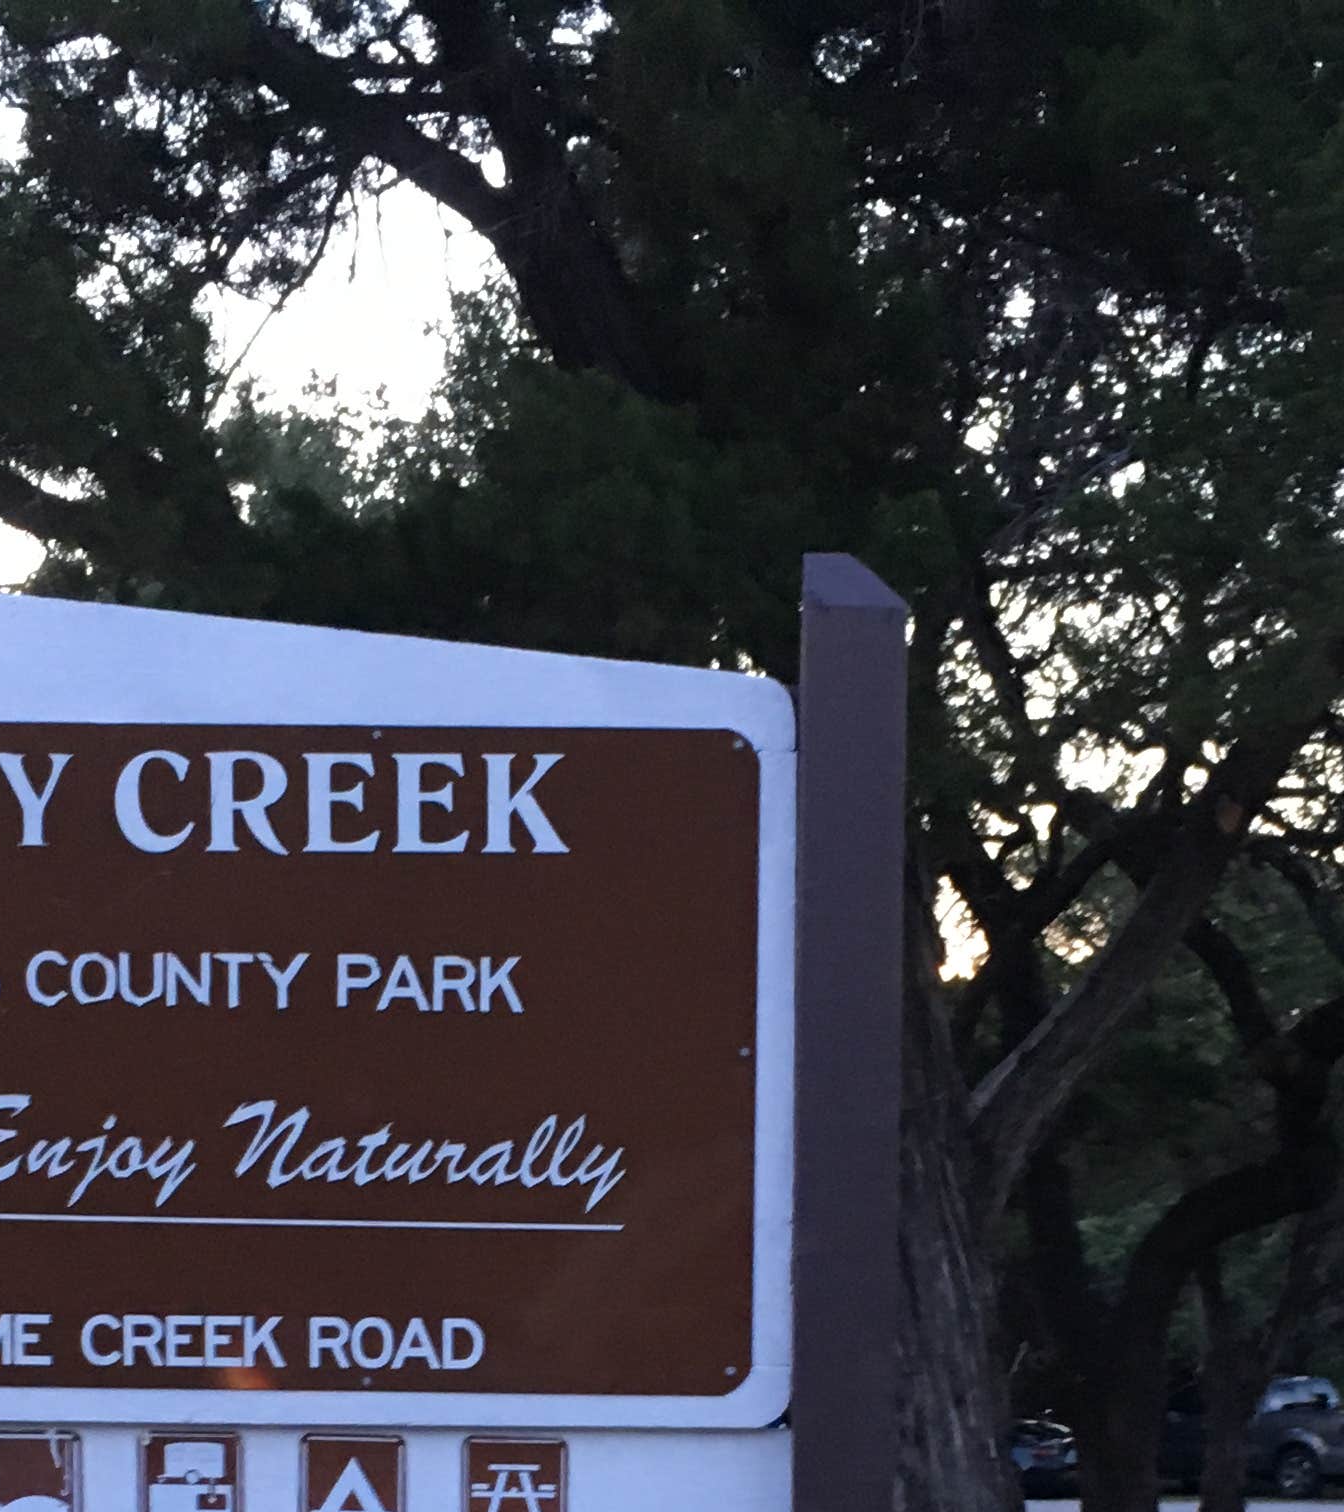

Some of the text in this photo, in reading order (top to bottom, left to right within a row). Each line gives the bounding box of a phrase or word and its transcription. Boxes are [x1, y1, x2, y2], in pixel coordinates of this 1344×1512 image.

[115, 750, 569, 855] CREEK
[26, 951, 309, 1009] COUNTY
[337, 954, 523, 1012] PARK
[223, 1100, 625, 1213] Naturally
[81, 1315, 286, 1367] CREEK
[309, 1317, 483, 1369] ROAD
